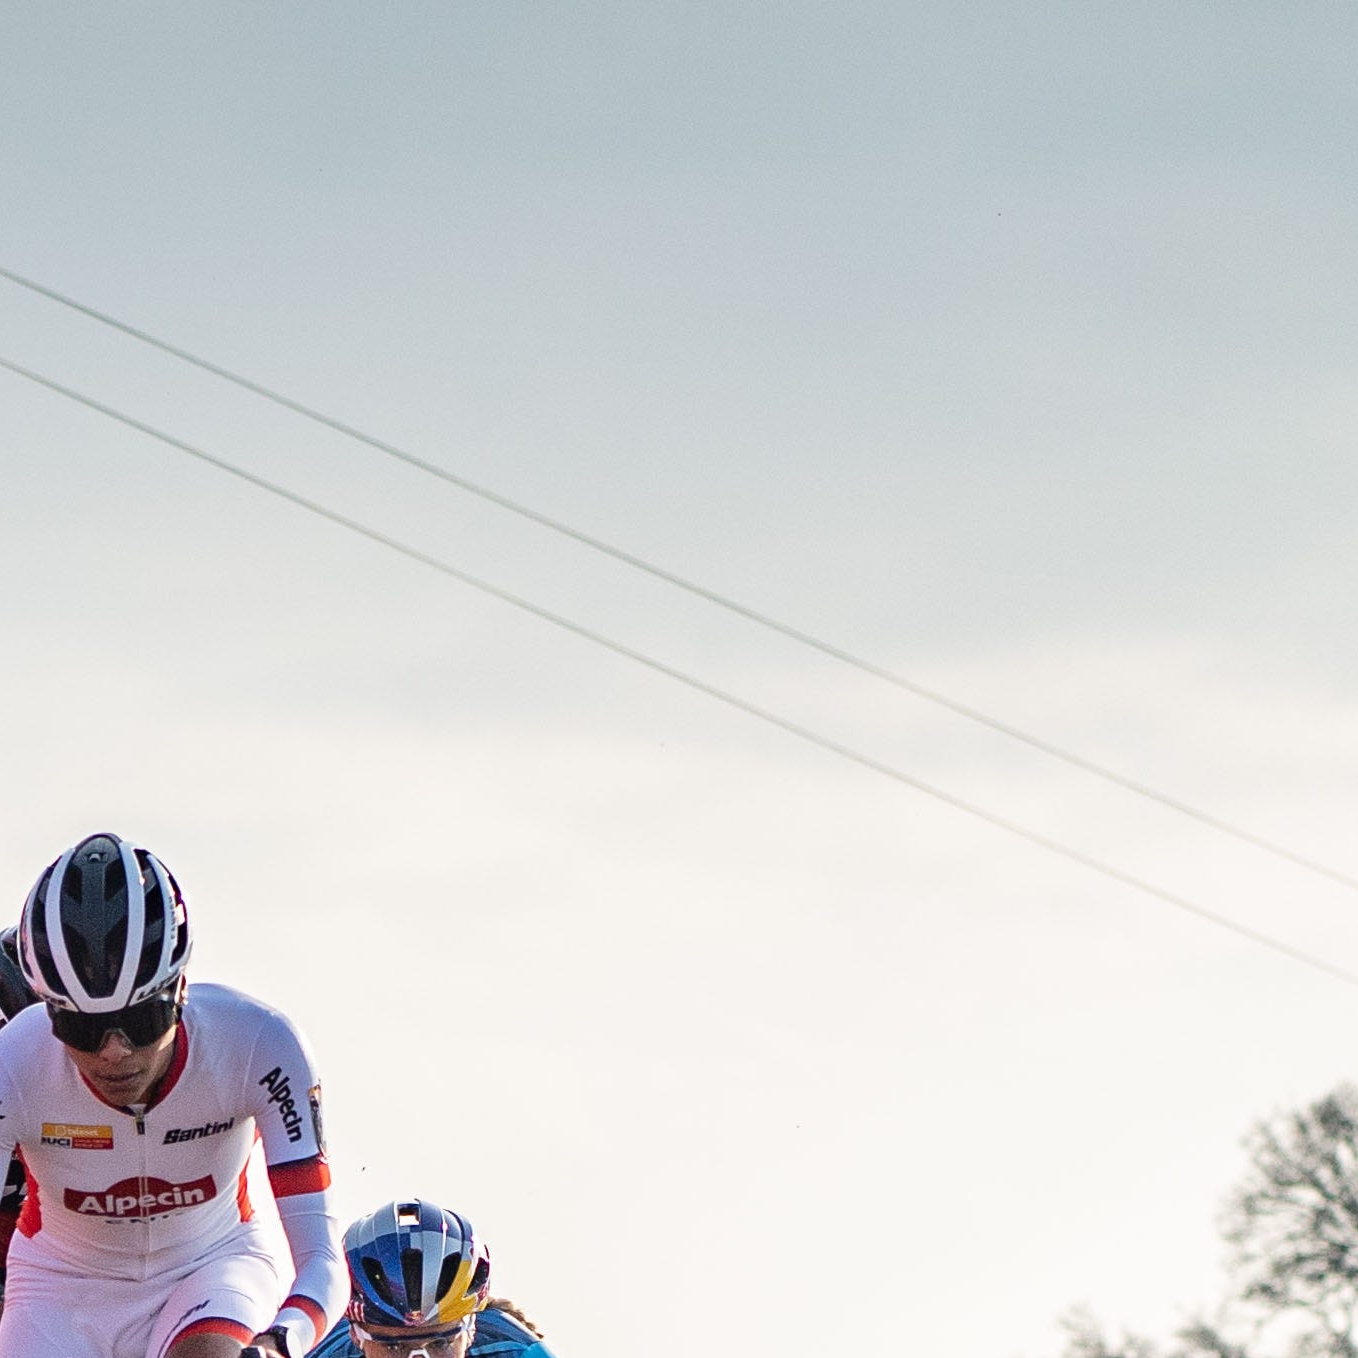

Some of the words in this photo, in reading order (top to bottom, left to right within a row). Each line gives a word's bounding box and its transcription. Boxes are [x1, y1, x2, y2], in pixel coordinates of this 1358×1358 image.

[258, 1066, 303, 1143] Alpecin
[47, 1137, 70, 1146] UCI
[163, 1117, 235, 1145] Santini
[77, 1187, 205, 1215] Alpecin
